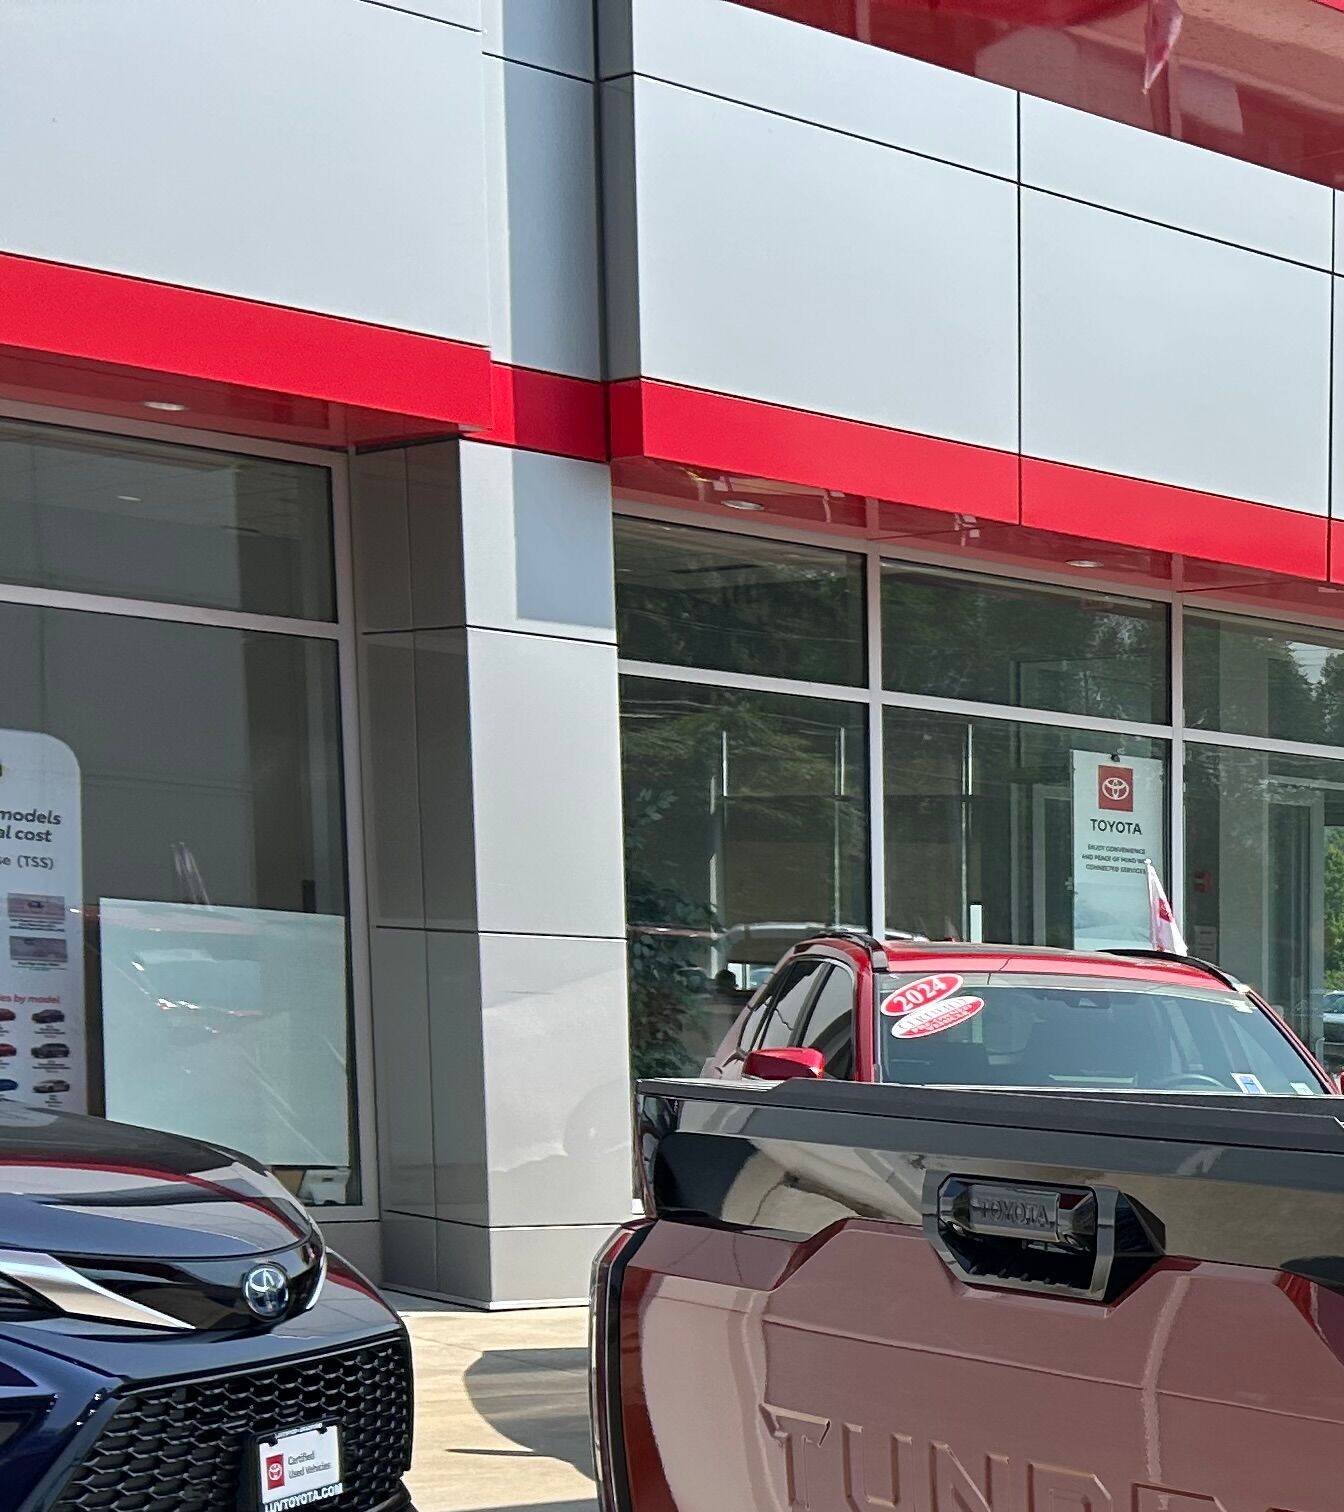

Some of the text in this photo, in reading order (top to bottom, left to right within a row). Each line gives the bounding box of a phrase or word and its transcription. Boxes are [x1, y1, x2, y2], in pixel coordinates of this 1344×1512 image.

[0, 809, 61, 825] models
[1089, 818, 1143, 835] TOYOTA
[15, 830, 52, 842] cost
[17, 855, 54, 870] (TSS)
[892, 977, 948, 1012] 2024
[979, 1199, 1051, 1228] TOYOTA
[287, 1450, 316, 1466] Certified
[288, 1467, 305, 1479] Used
